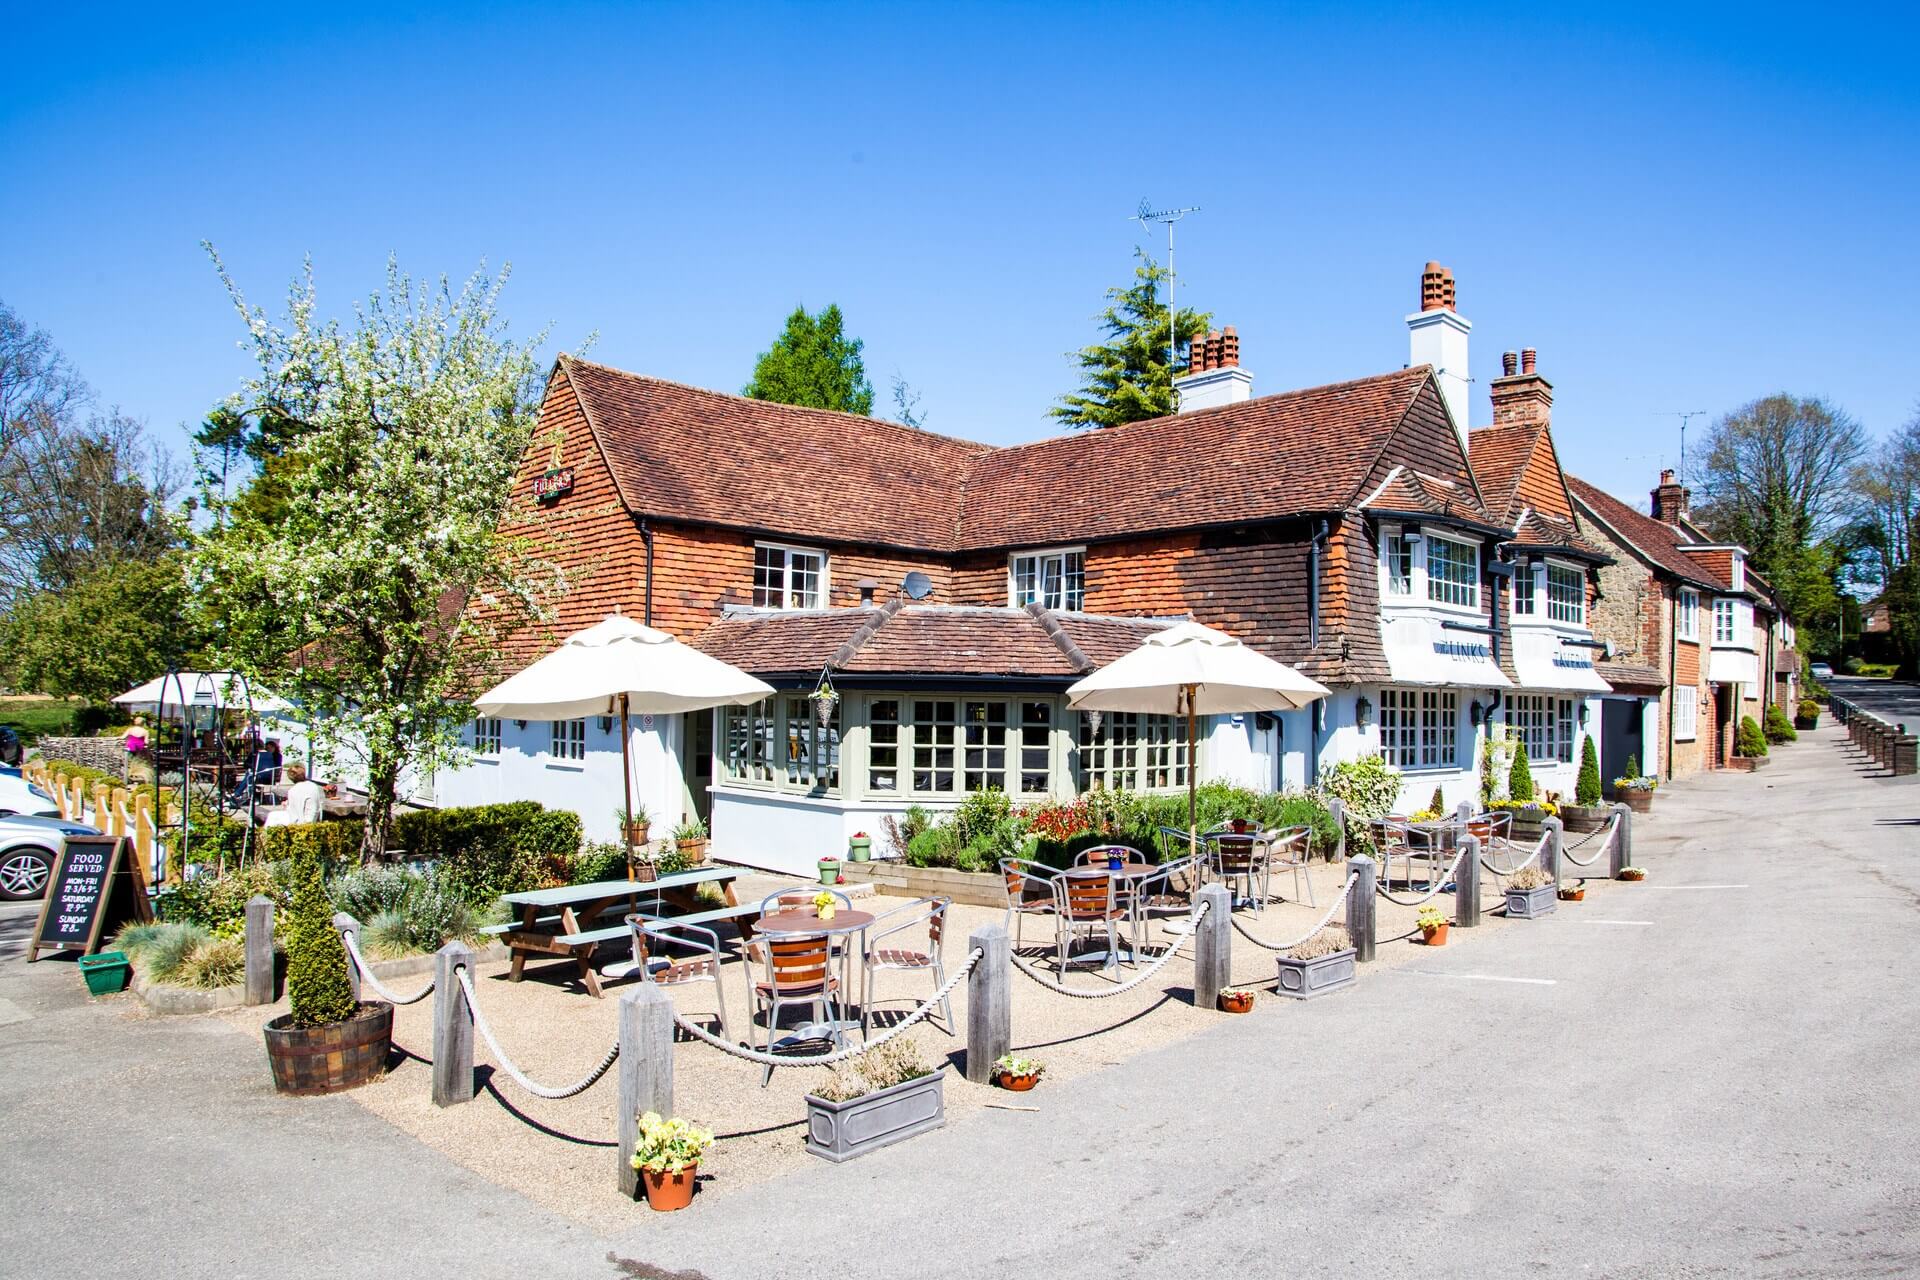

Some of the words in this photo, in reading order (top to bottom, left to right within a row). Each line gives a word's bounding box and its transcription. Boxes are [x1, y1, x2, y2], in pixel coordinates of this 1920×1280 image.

[1450, 640, 1485, 664] LINKS
[73, 854, 103, 864] FOOD
[61, 895, 95, 903] SATURDAY
[59, 915, 87, 923] SUNDAY
